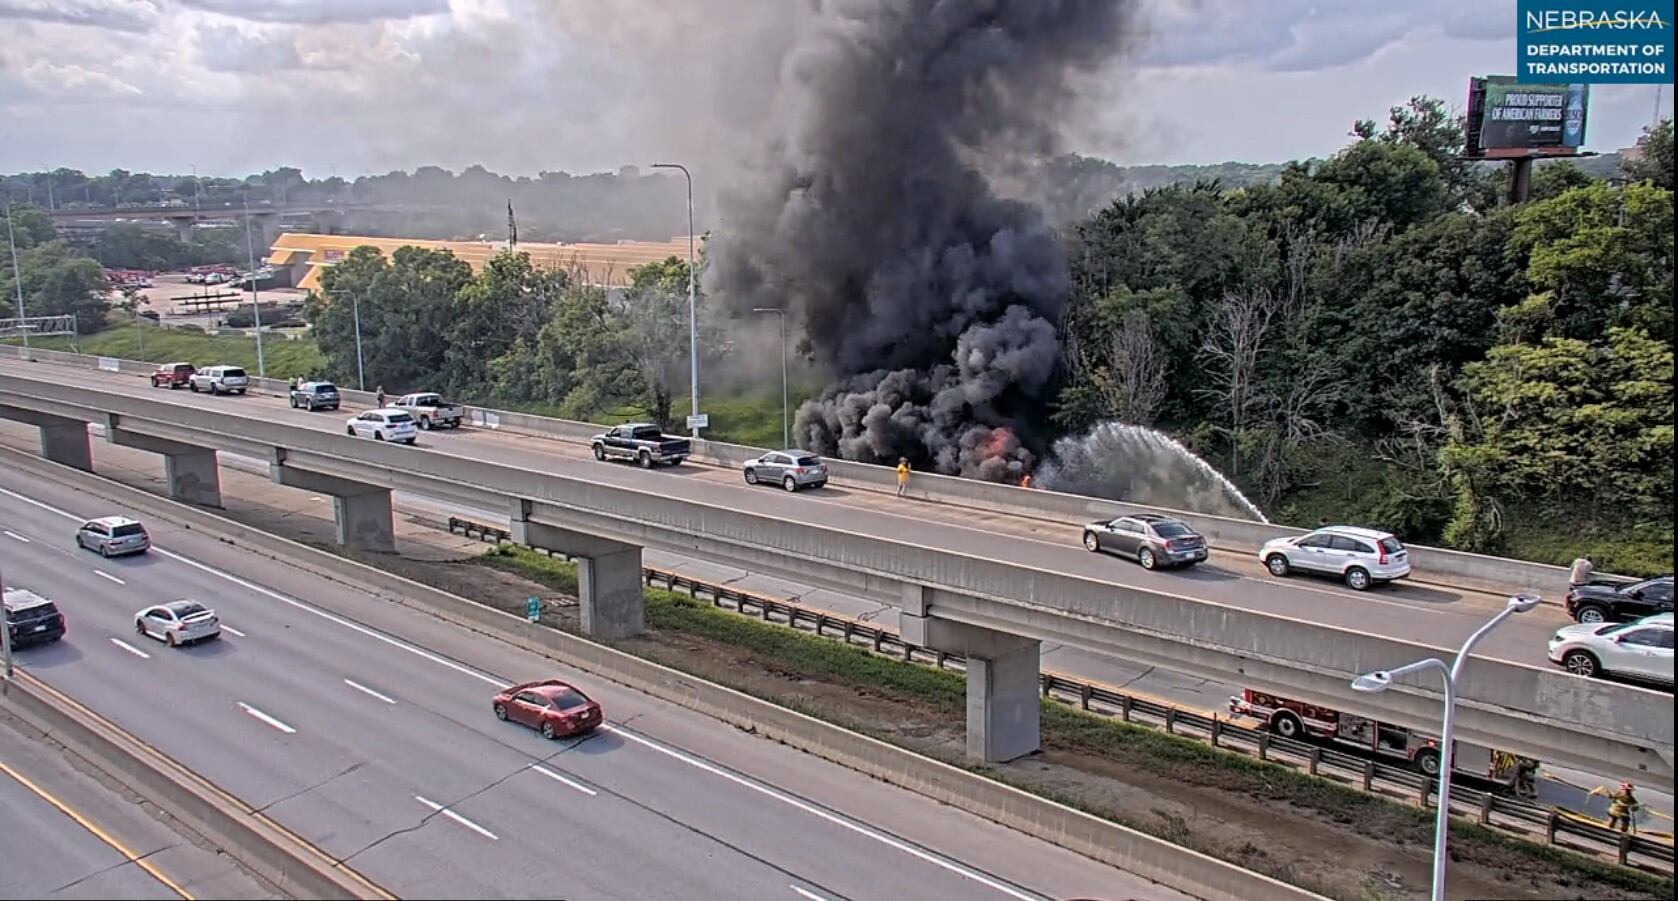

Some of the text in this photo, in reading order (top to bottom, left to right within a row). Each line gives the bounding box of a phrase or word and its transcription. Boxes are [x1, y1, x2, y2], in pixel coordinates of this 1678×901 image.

[1505, 93, 1564, 107] PROUD SUPPORTER
[1491, 107, 1503, 120] OF
[1502, 107, 1535, 120] AMERICAN
[1534, 107, 1562, 120] FARMERS
